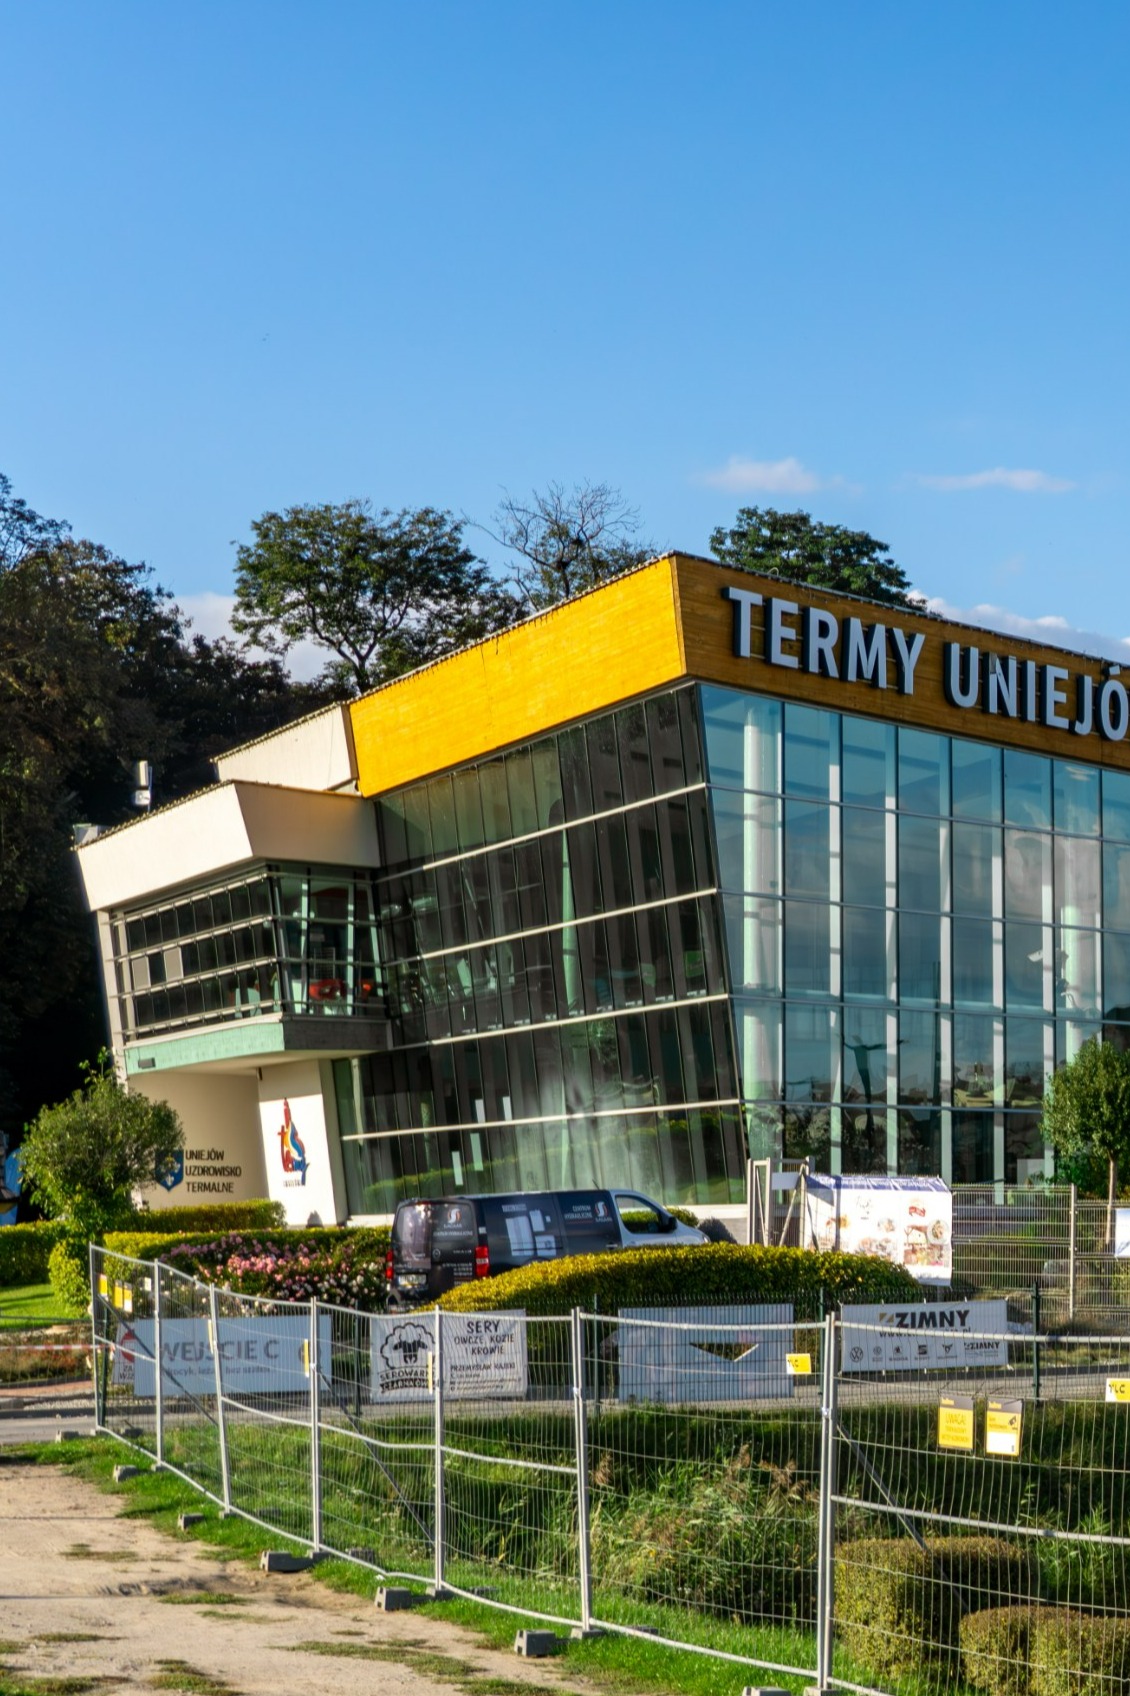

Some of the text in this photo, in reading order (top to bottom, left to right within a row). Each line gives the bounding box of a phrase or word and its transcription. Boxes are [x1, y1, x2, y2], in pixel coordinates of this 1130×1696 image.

[723, 587, 925, 695] TERMY
[185, 1148, 225, 1161] UNIEJÓW
[185, 1165, 242, 1177] UZDROWISKO
[186, 1181, 234, 1193] TERMALNE
[895, 1309, 970, 1329] ZIMNY
[467, 1320, 499, 1334] SERY
[490, 1334, 515, 1344] KOZIE
[969, 1341, 1000, 1350] ZIMNY
[264, 1339, 280, 1360] C
